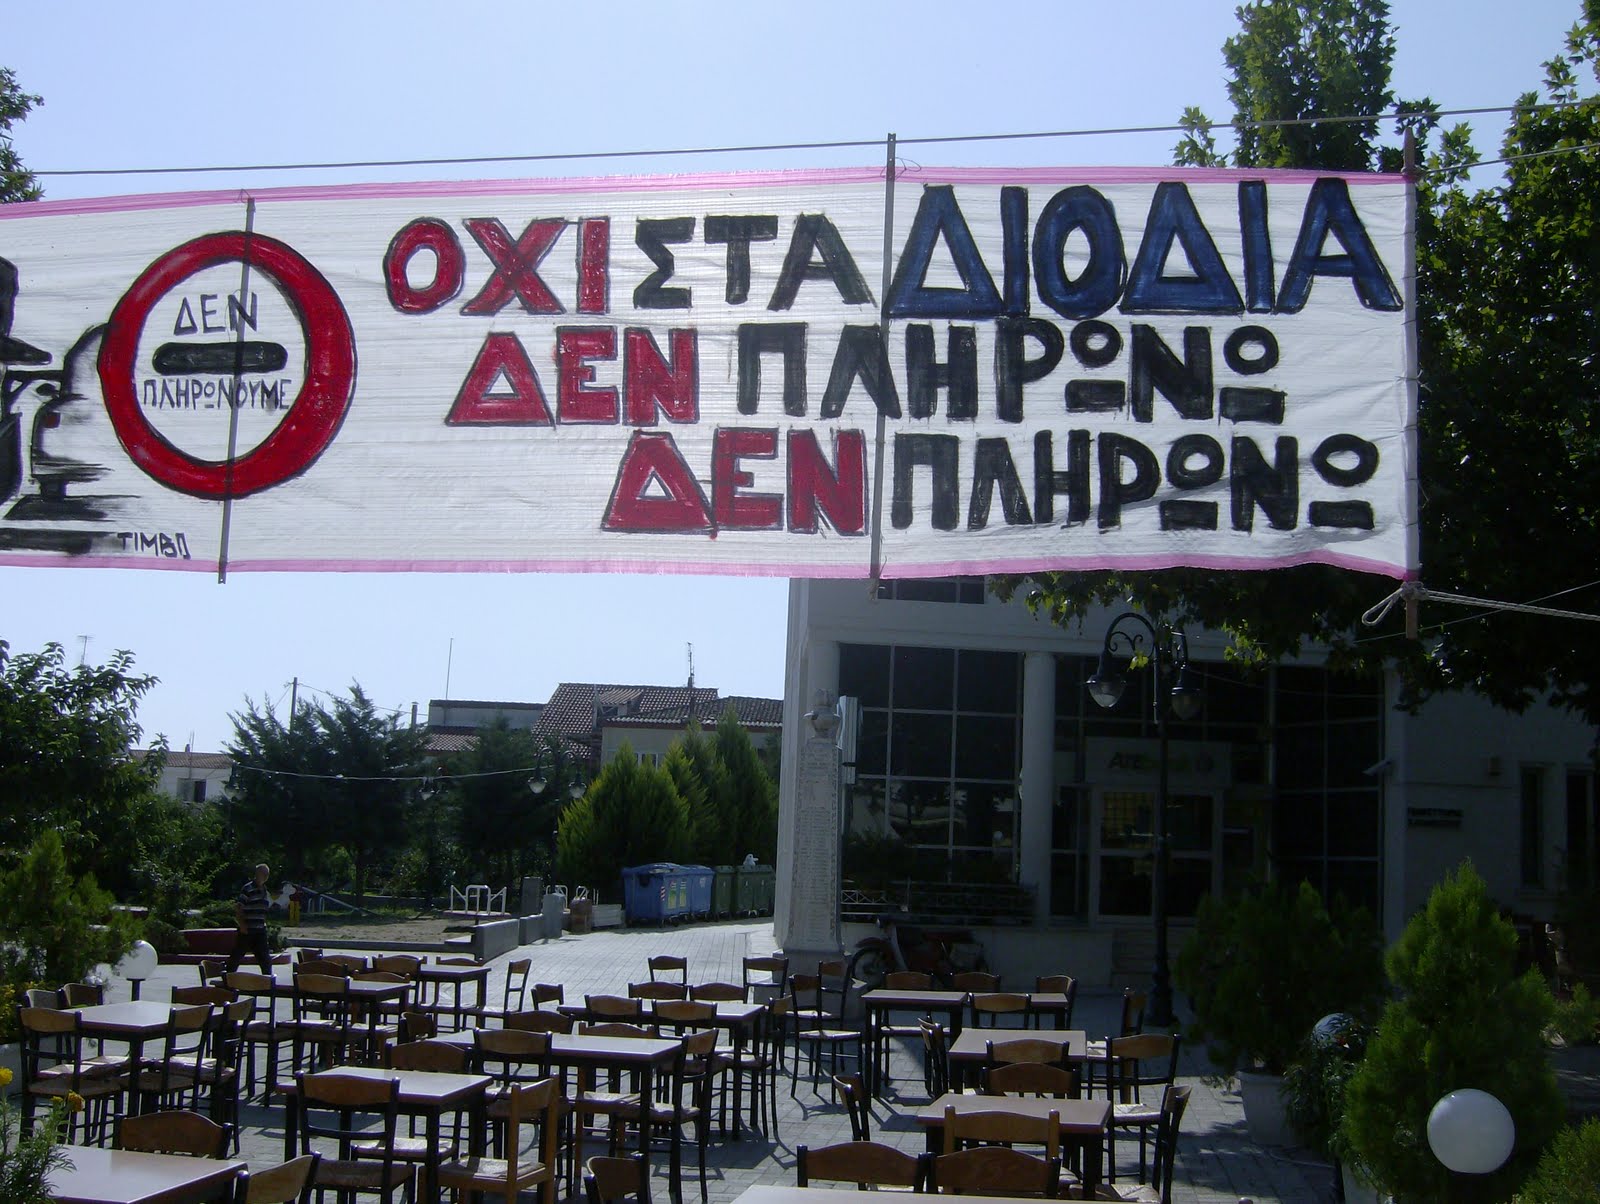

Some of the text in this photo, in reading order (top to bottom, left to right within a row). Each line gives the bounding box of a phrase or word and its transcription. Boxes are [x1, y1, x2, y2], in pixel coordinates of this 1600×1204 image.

[383, 177, 1405, 320] ΟΧΙ ΣΤΑ ΔΙΟΔΙΑ
[174, 291, 258, 336] ΔΕΝ
[445, 318, 1288, 428] ΔΕΝ ΠΛΗΡΩΝΩ
[600, 426, 1380, 537] ΔΕΝ ΠΛΗΡΩΝΩ
